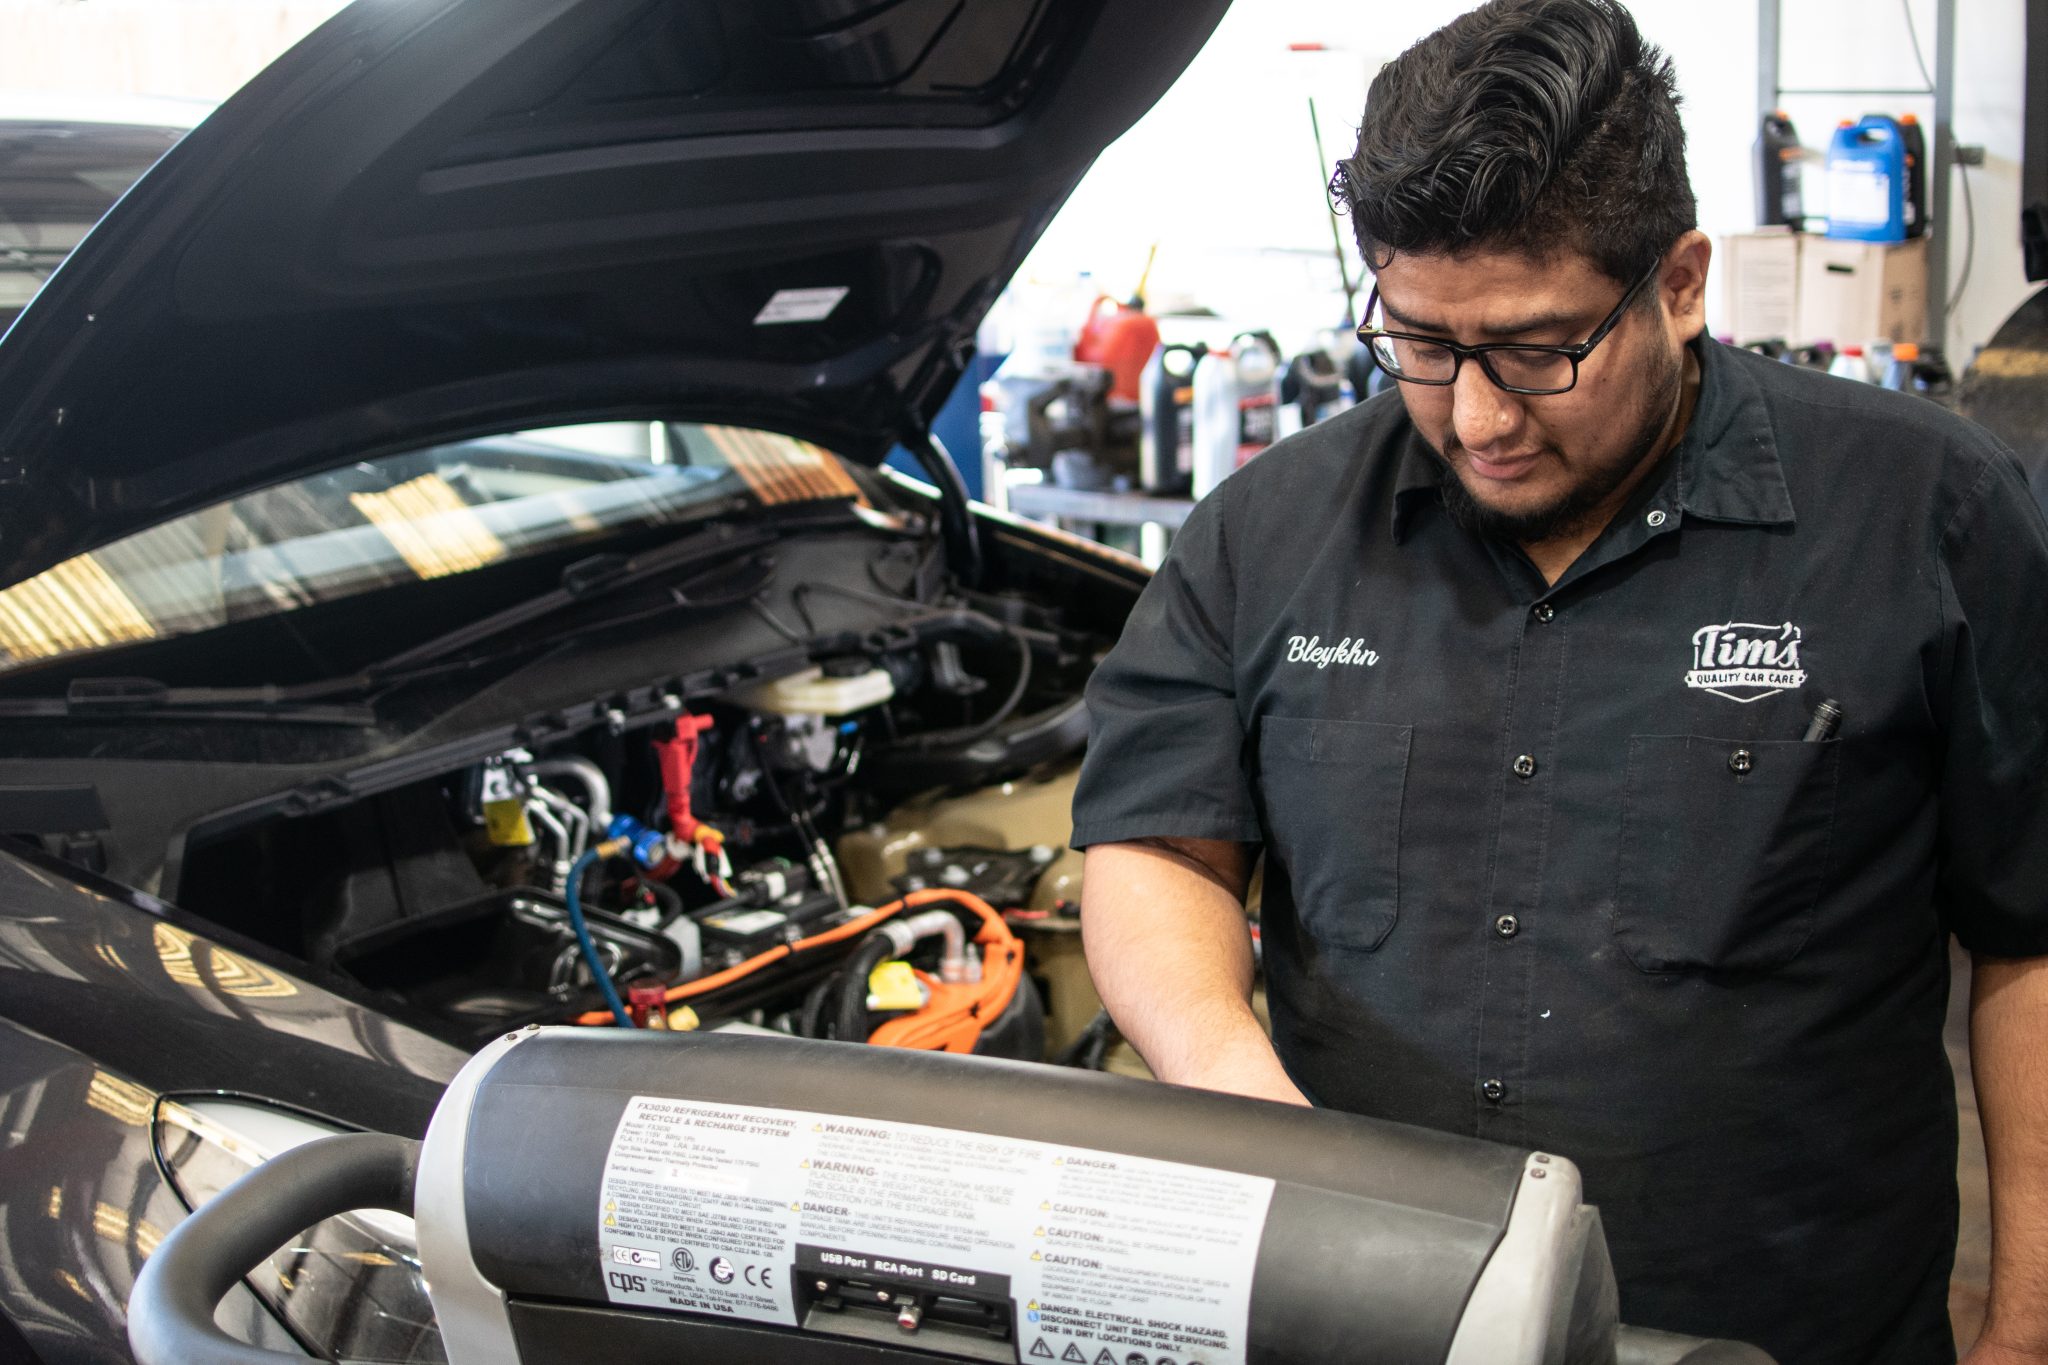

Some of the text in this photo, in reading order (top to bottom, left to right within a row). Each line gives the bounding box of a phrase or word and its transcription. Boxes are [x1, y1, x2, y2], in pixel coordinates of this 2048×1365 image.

[1287, 635, 1379, 669] Bleykhn
[1692, 620, 1801, 668] Tim's
[1697, 673, 1794, 684] QUALITY CAR CARE
[637, 1102, 797, 1129] FX3030 REFRIGERANT RECOVERY,
[639, 1112, 681, 1125] RECYCLE
[694, 1118, 747, 1132] RECHARGE
[749, 1126, 790, 1138] SYSTEM
[825, 1122, 892, 1141] WARNING:
[896, 1132, 909, 1142] TO
[911, 1134, 951, 1148] REDUCE
[955, 1140, 971, 1151] THE
[975, 1143, 999, 1155] RISK
[1001, 1146, 1015, 1157] OF
[1018, 1149, 1042, 1161] FIRE
[804, 1188, 862, 1204] PROTECTION
[864, 1196, 883, 1207] FOR
[886, 1199, 903, 1210] THE
[906, 1202, 950, 1217] STORAGE
[808, 1179, 824, 1190] THE
[827, 1182, 854, 1194] SCALE
[856, 1186, 866, 1195] IS
[869, 1188, 888, 1198] THE
[888, 1190, 928, 1204] PRIMARY
[1053, 1203, 1109, 1219] CAUTION:
[1047, 1226, 1104, 1243] CAUTION:
[821, 1253, 976, 1285] USB Port RCA Port SD Card
[1044, 1253, 1103, 1270] CAUTION:
[651, 1279, 664, 1287] CPS
[669, 1296, 697, 1307] MADE
[713, 1304, 734, 1313] USA
[1041, 1303, 1228, 1339] DANGER: ELECTRICAL SHOCK HAZARD.
[1041, 1314, 1230, 1349] DISCONNECT UNIT BEFORE SERVICING.
[1041, 1324, 1183, 1353] USE IN DRY LOCATIONS ONLY.
